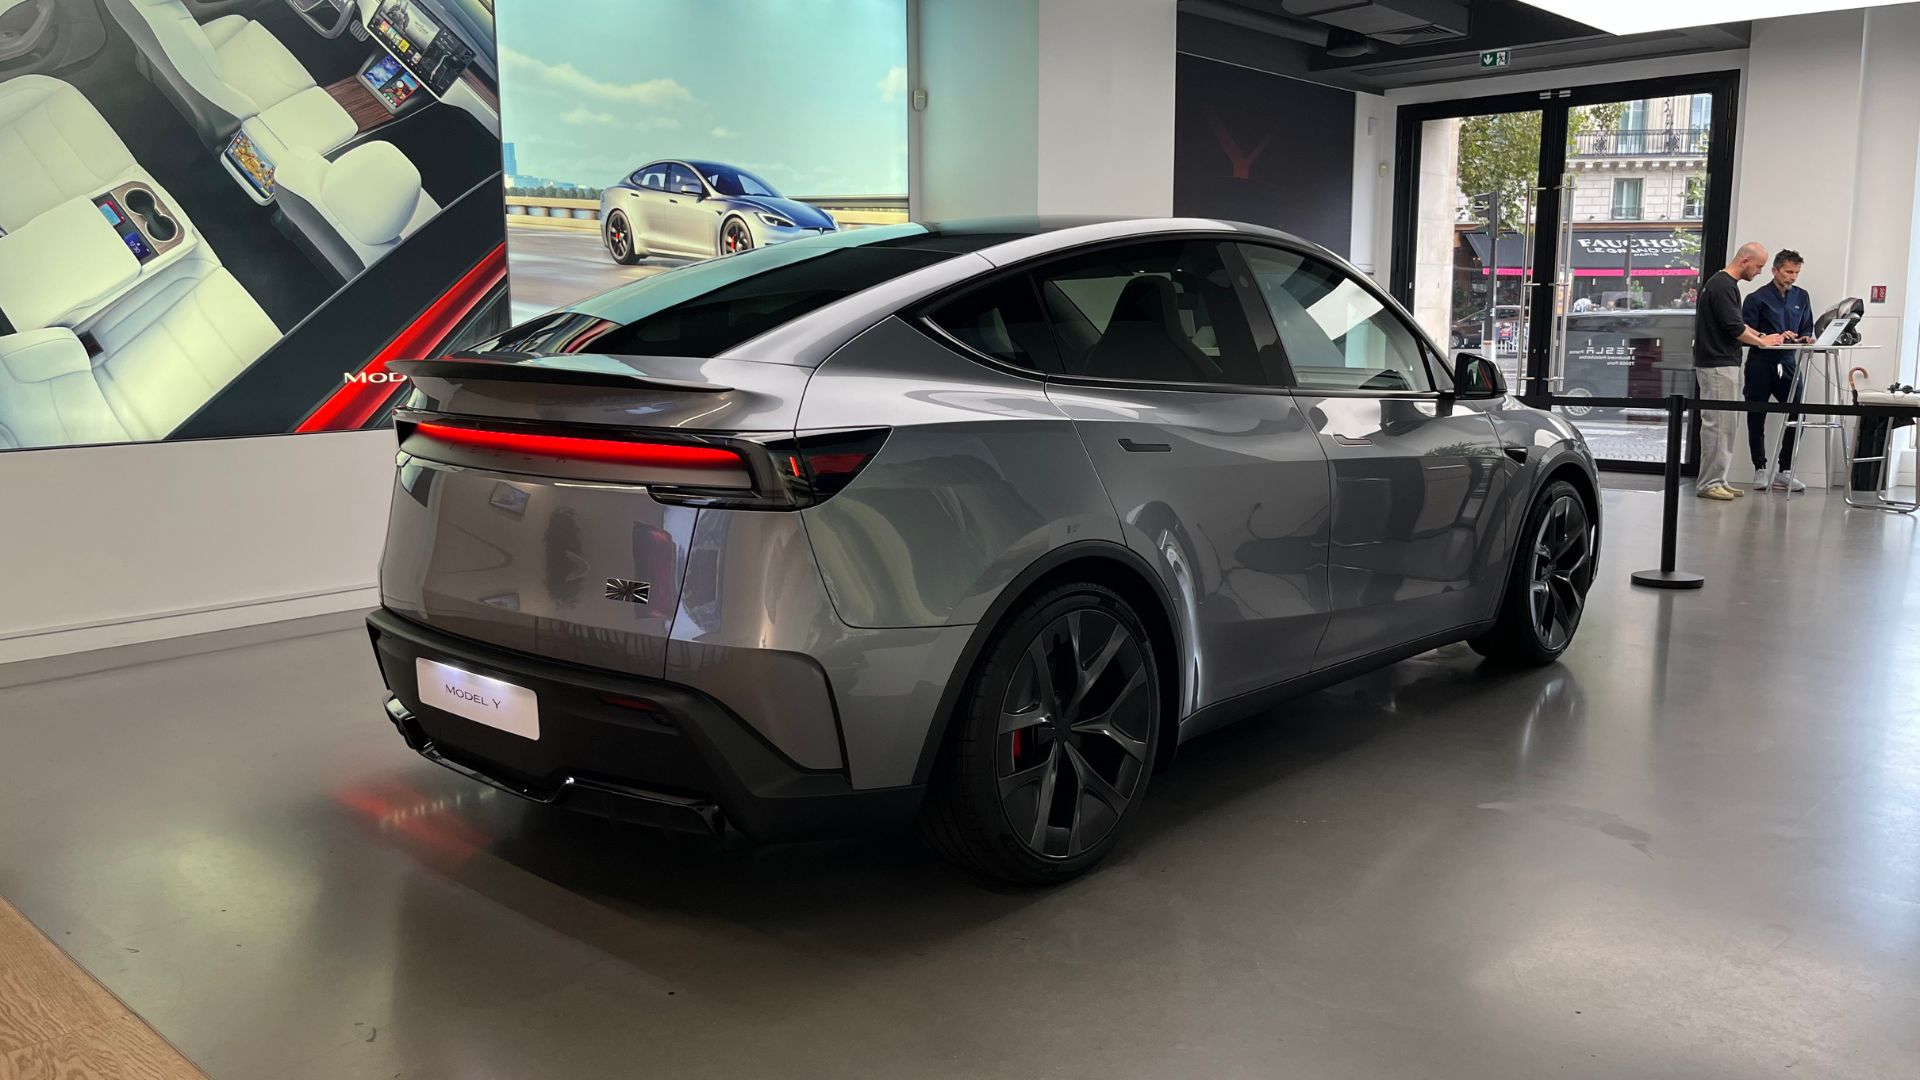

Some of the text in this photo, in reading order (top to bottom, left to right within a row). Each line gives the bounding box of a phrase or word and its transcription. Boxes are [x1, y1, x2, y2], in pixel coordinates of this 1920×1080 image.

[1577, 238, 1697, 248] FAUCHON
[344, 372, 408, 384] MOD
[446, 684, 500, 709] MODEL Y
